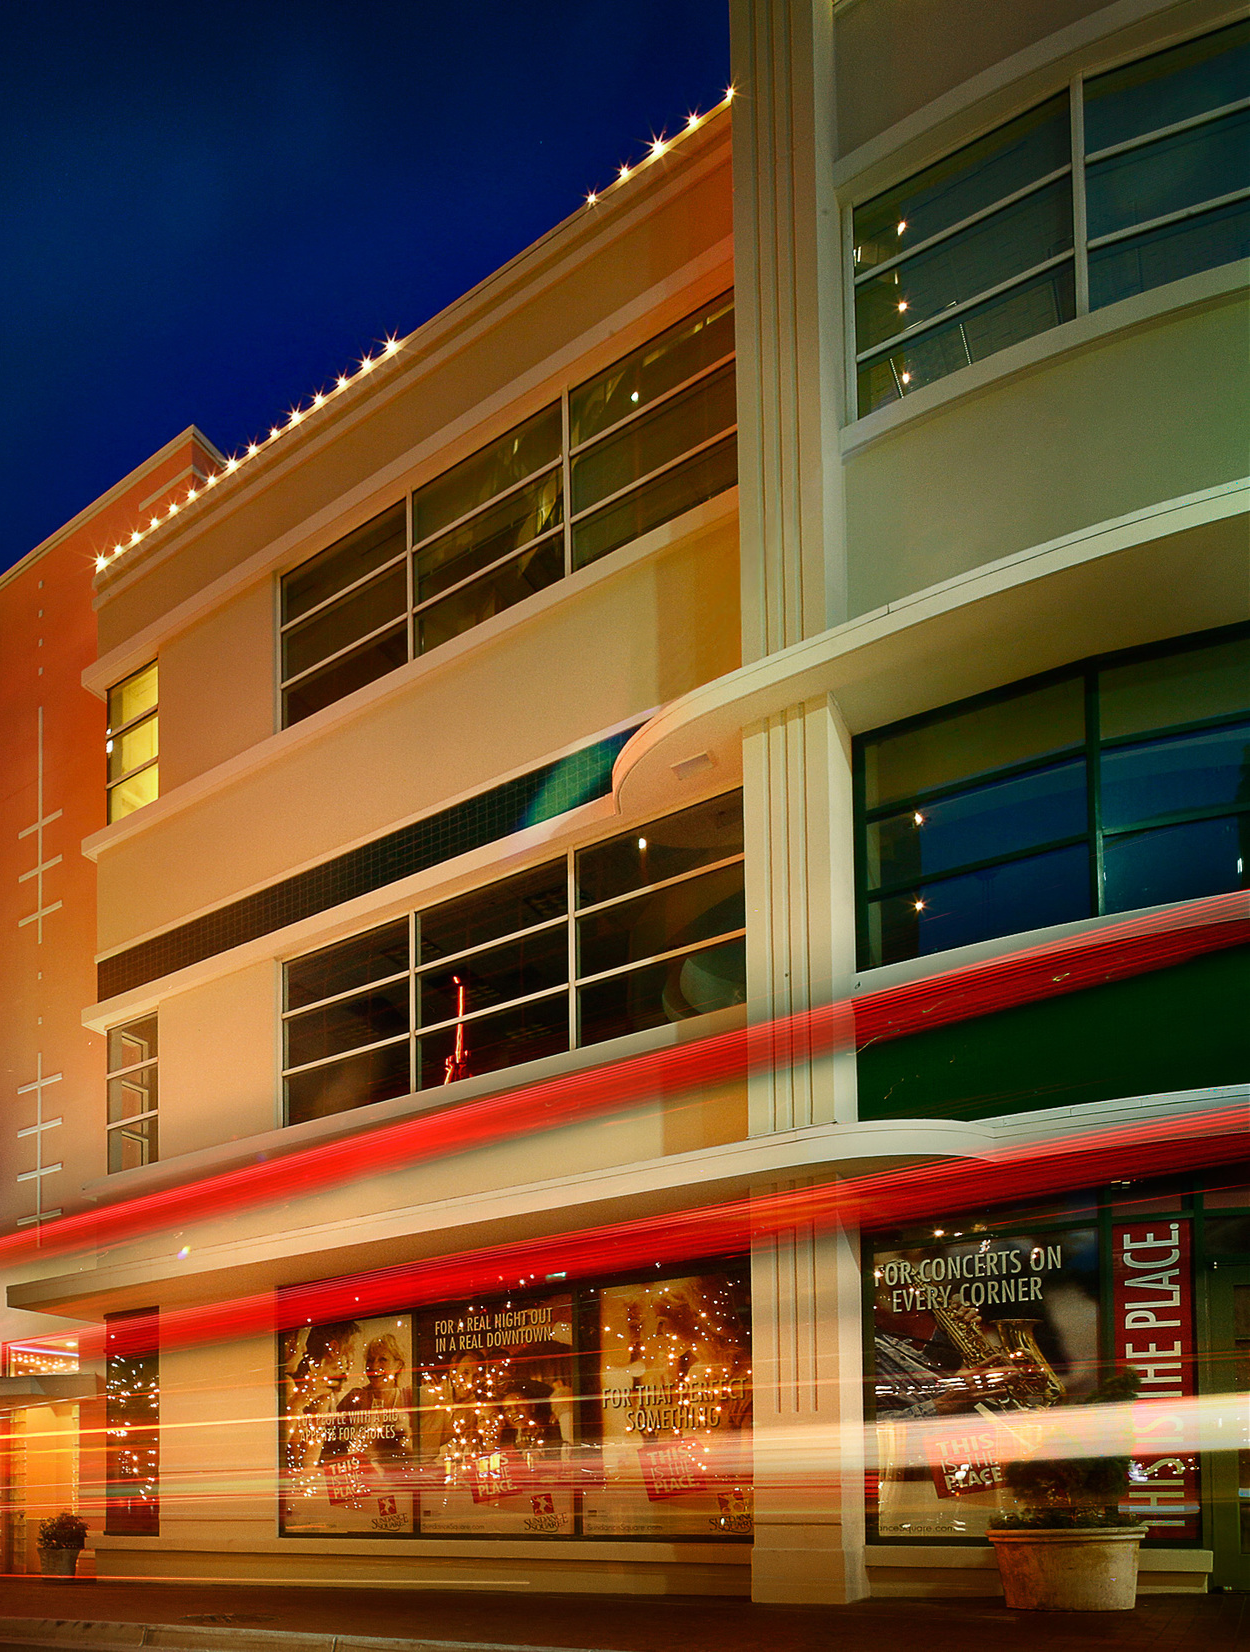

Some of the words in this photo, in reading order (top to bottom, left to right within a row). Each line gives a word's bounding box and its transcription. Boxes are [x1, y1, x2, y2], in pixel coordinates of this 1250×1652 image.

[874, 1262, 912, 1287] FOR
[918, 1249, 1022, 1283] CONCERTS
[1030, 1245, 1062, 1272] ON
[1122, 1222, 1181, 1329] PLACE.
[892, 1285, 952, 1313] EVERY
[959, 1277, 1044, 1308] CORNER
[434, 1320, 454, 1336] FOR
[456, 1319, 464, 1333] A
[466, 1315, 492, 1332] REAL
[494, 1310, 528, 1329] NIGHT
[530, 1307, 553, 1326] OUT
[435, 1338, 446, 1353] IN
[449, 1337, 457, 1352] A
[459, 1334, 484, 1351] REAL
[486, 1326, 551, 1348] DOWNTOWN
[602, 1388, 631, 1408] FOR
[635, 1383, 674, 1406] THAT
[679, 1377, 749, 1403] PERFECT
[626, 1406, 720, 1432] SOMETHING
[1131, 1414, 1184, 1444] IS
[339, 1426, 356, 1441] FOR
[936, 1433, 995, 1457] THIS
[329, 1458, 360, 1475] THIS
[646, 1445, 690, 1466] THIS
[940, 1457, 958, 1474] IS
[965, 1449, 998, 1469] THE
[651, 1465, 664, 1480] IS
[668, 1459, 694, 1476] THE
